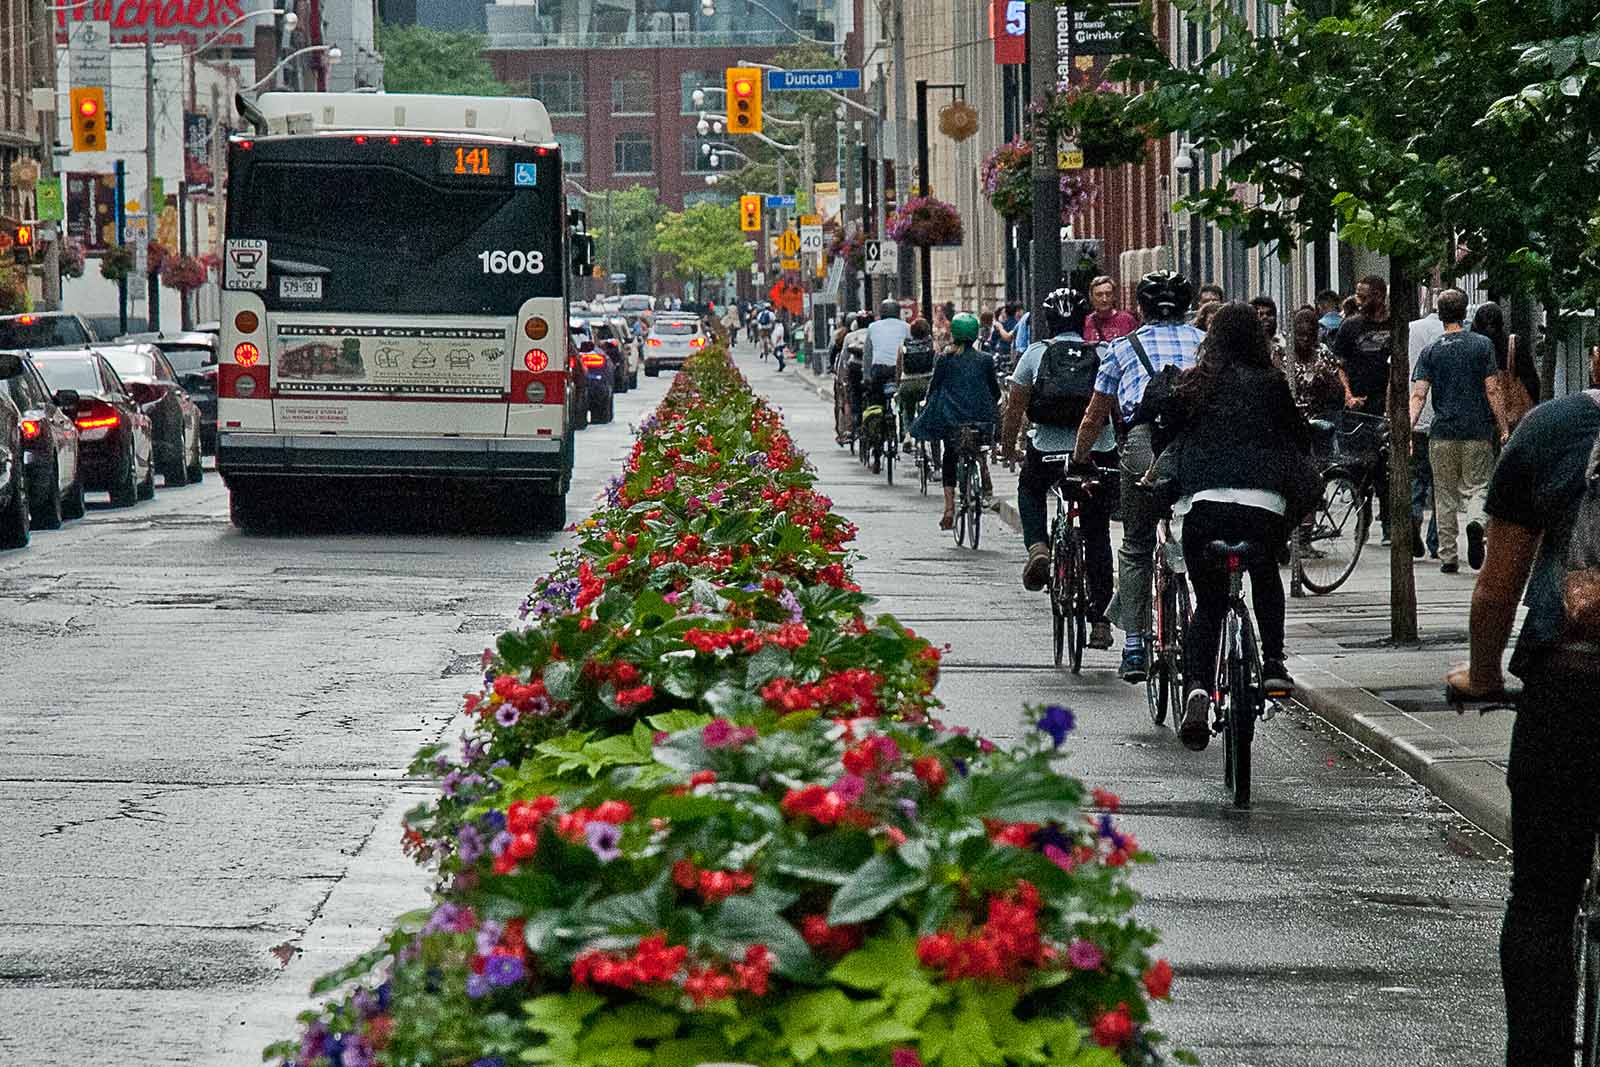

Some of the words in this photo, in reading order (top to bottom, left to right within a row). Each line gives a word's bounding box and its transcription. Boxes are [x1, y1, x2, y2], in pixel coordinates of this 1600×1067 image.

[1006, 1, 1026, 35] 5
[784, 72, 833, 86] Duncan
[454, 147, 491, 175] 141
[230, 240, 263, 248] YIELD
[803, 235, 822, 248] 40
[478, 250, 544, 274] 1608
[420, 330, 504, 338] Leather
